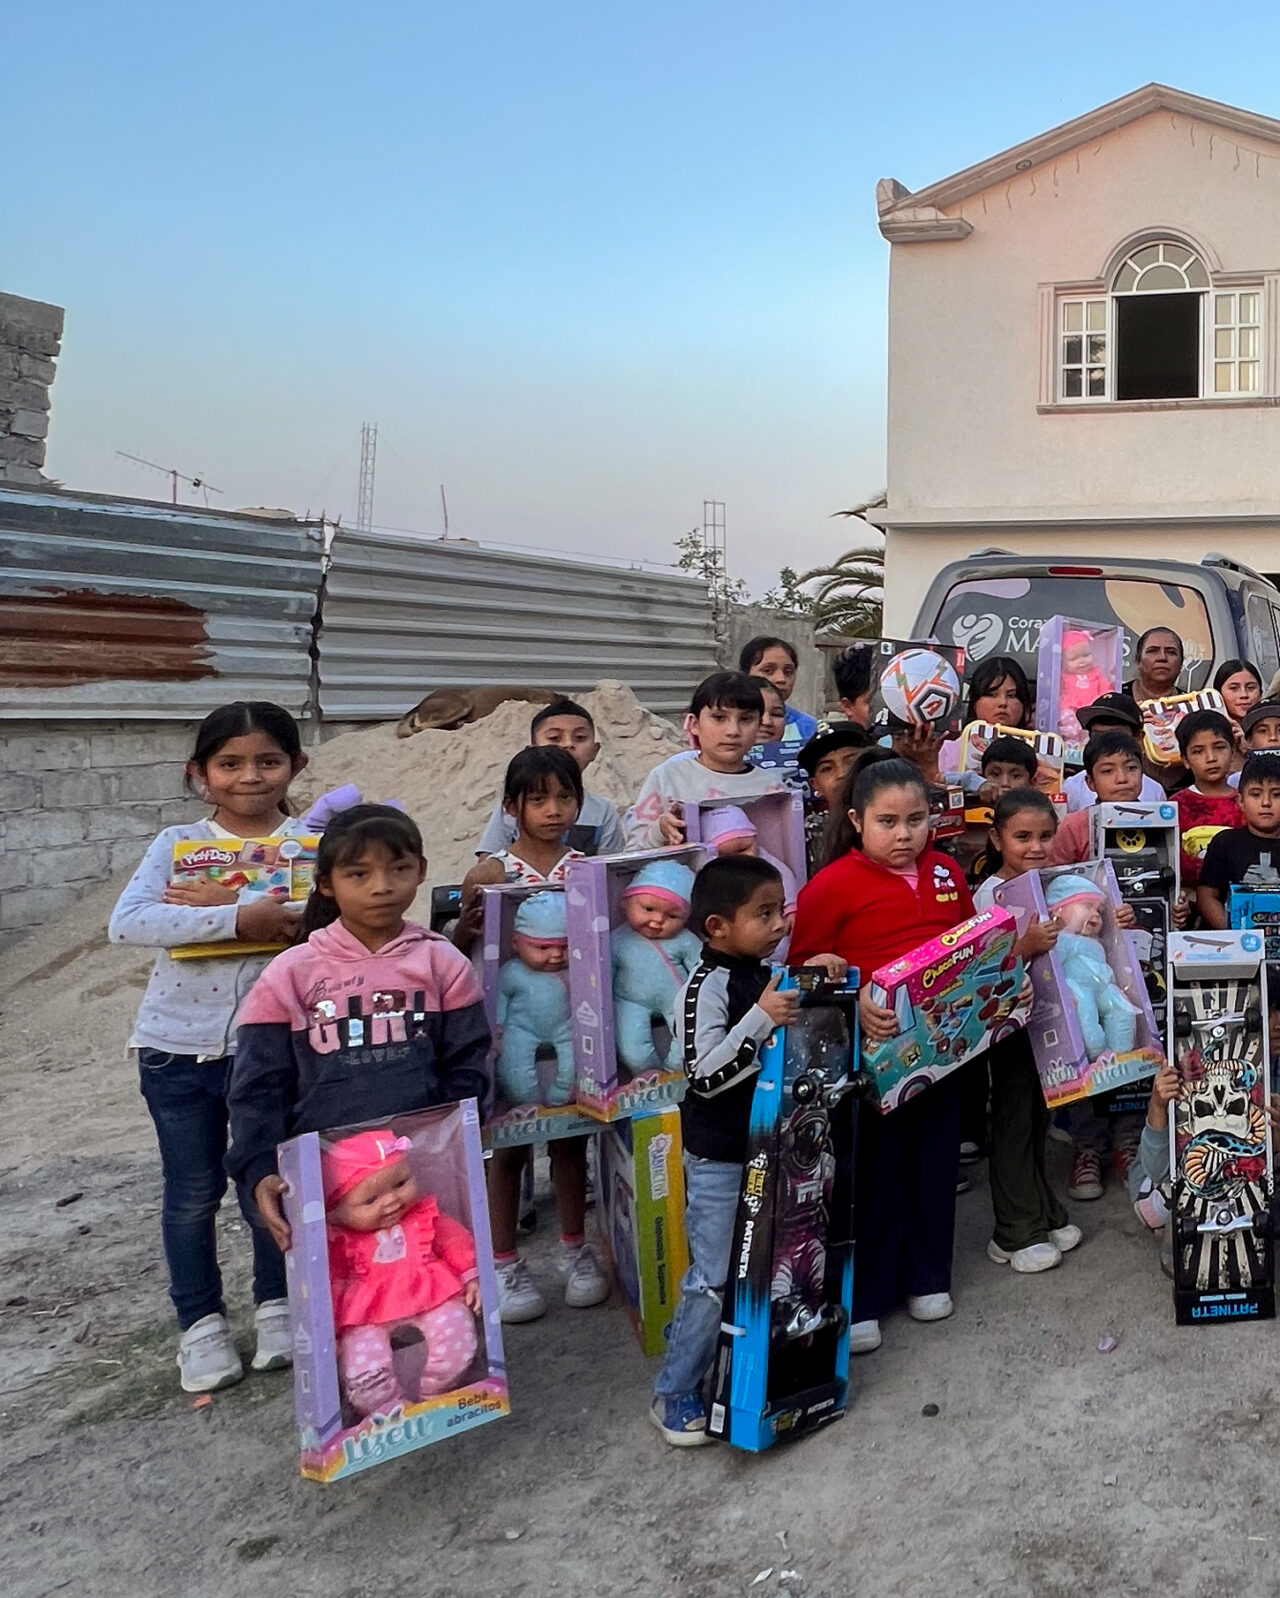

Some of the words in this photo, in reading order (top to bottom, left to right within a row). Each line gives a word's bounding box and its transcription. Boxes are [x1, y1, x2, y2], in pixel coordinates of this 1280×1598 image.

[1008, 616, 1046, 629] Cora
[737, 1220, 755, 1279] PATINETA
[1191, 1302, 1259, 1318] PATINETA
[446, 1400, 502, 1428] abracitos
